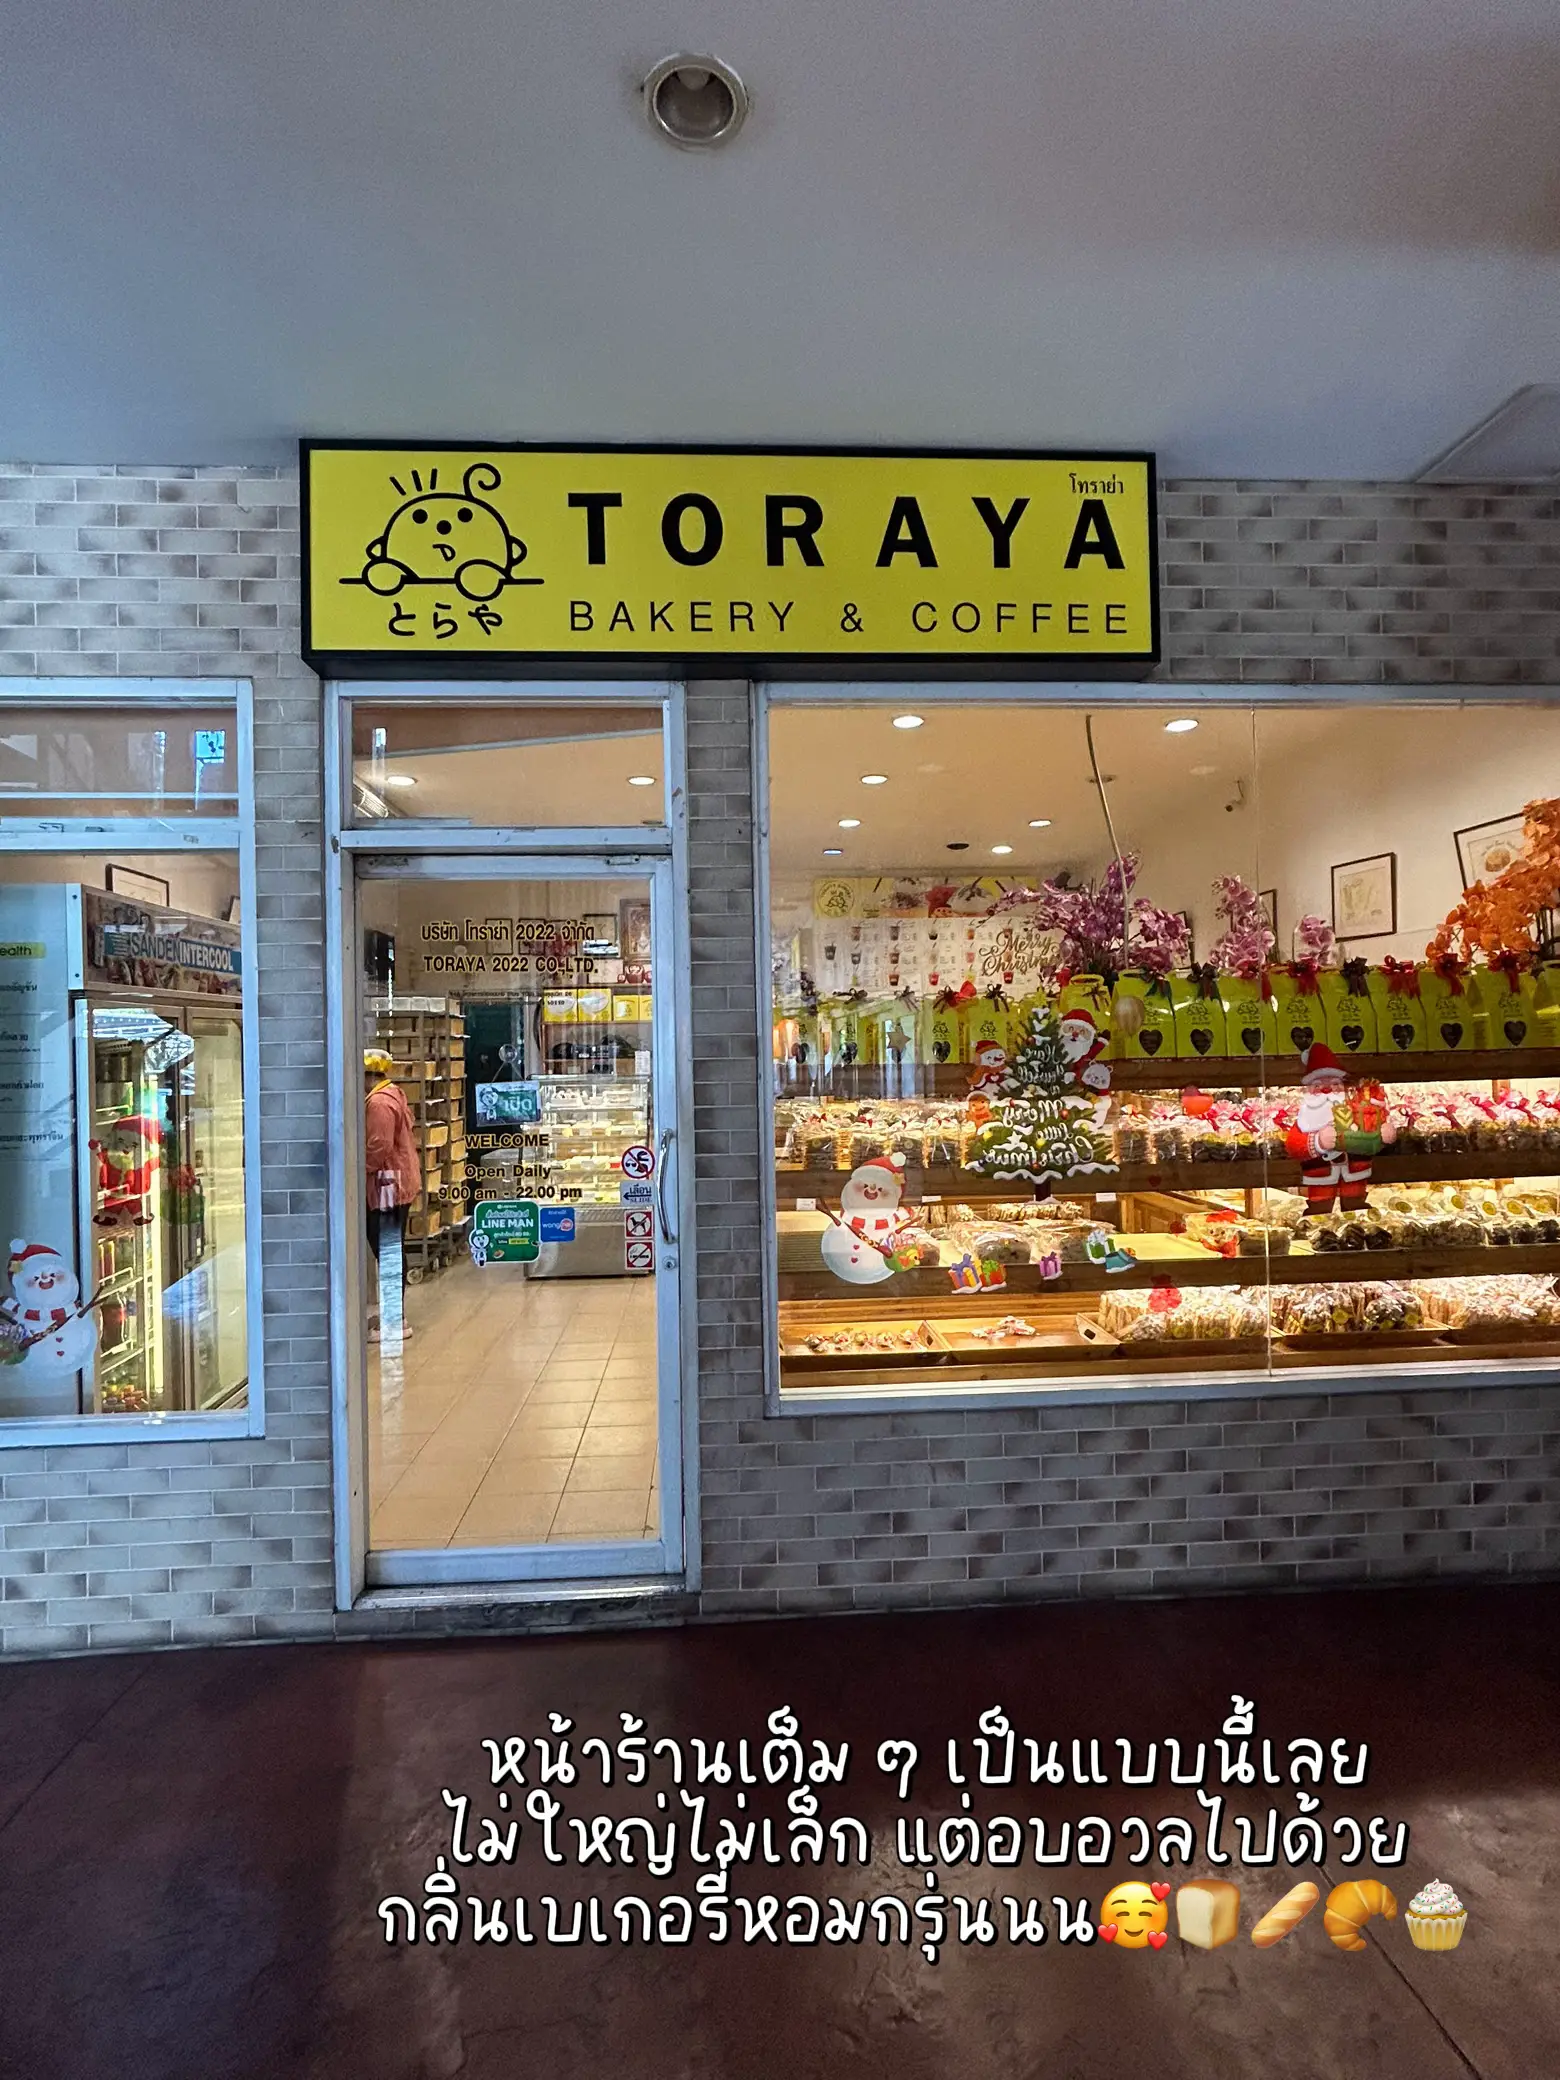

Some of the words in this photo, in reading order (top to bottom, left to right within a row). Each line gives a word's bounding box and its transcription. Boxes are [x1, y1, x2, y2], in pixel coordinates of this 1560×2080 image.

[1068, 472, 1124, 494] โทราย่า
[568, 492, 1126, 570] TORAYA
[387, 602, 504, 639] とらや
[569, 600, 795, 632] BAKERY
[840, 602, 864, 633] &
[911, 601, 1128, 633] COFFEE
[421, 920, 458, 940] บริษัท
[465, 918, 509, 940] โทราย่า
[516, 923, 555, 940] 2022
[561, 920, 595, 940] จำกัด
[130, 932, 180, 962] SANDEN
[180, 941, 234, 971] INTERCOOL
[424, 956, 486, 973] TORAYA
[492, 956, 529, 973] 2022
[464, 1133, 550, 1149] WELCOME
[464, 1165, 506, 1180] Open
[513, 1164, 551, 1180] Daily
[438, 1187, 470, 1200] 9.00
[475, 1188, 497, 1199] am
[516, 1187, 555, 1199] 22.00
[560, 1186, 583, 1201] pm
[629, 1183, 652, 1194] เลื่อน
[481, 1219, 507, 1229] LINE
[508, 1218, 534, 1228] MAN
